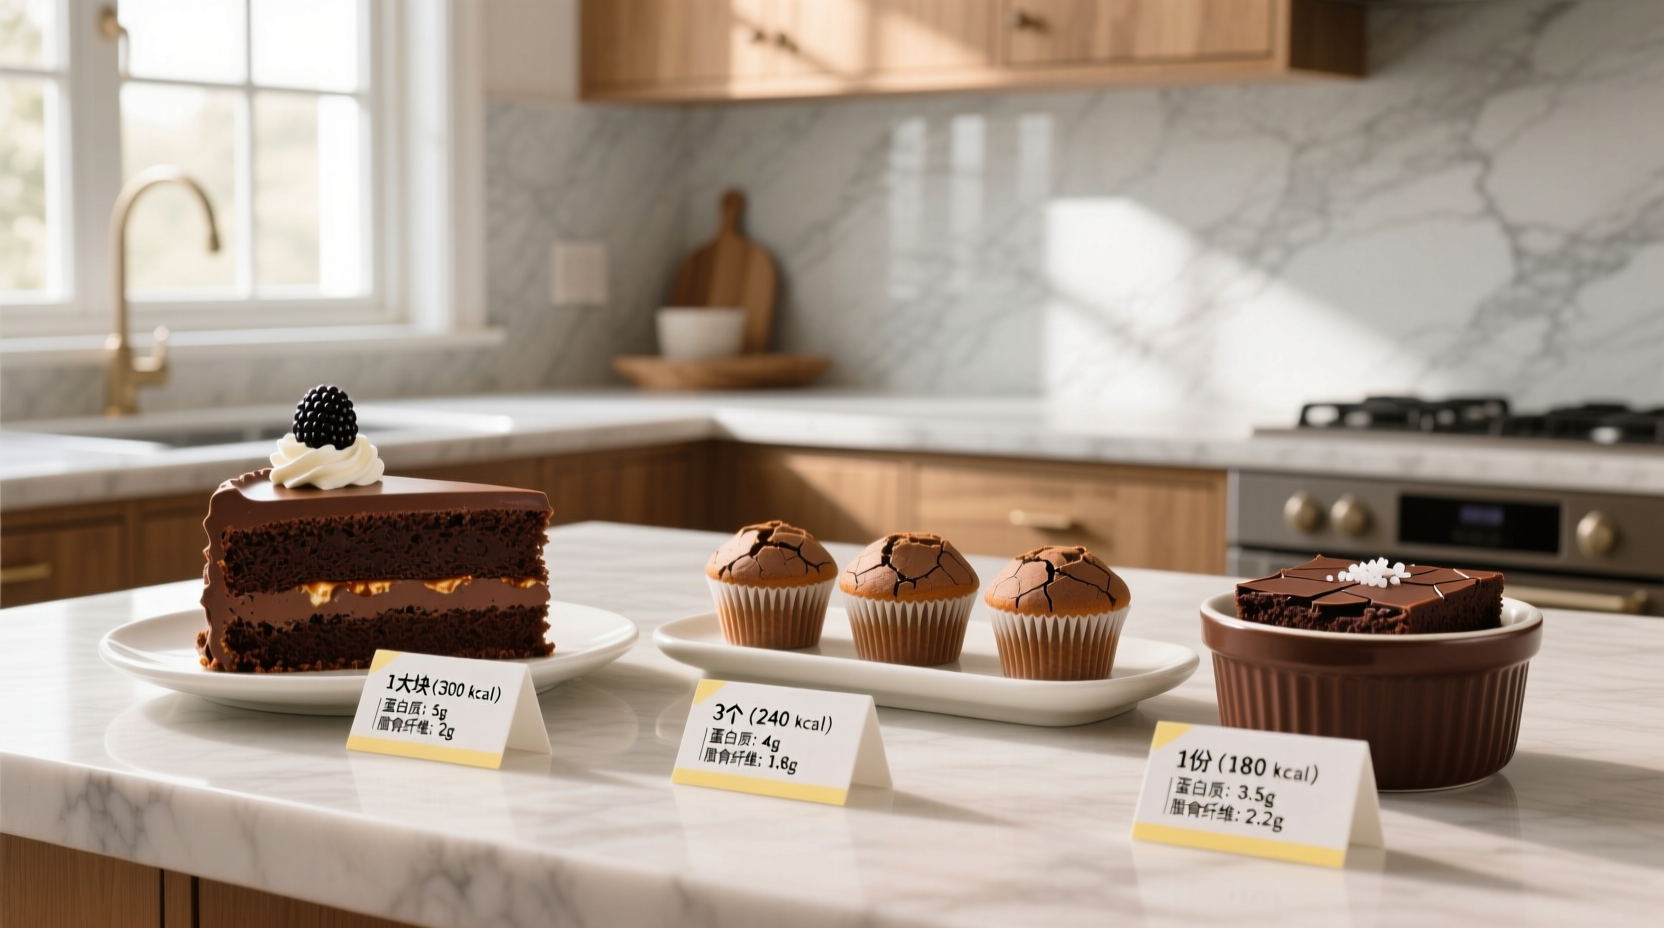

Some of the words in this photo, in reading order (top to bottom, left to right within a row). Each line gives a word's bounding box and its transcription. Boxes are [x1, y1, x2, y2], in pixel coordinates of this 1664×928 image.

[468, 685, 501, 704] kcal)
[432, 704, 448, 720] 5g
[713, 703, 743, 724] 3个
[750, 707, 790, 727] (240
[795, 715, 832, 735] kcal)
[438, 722, 455, 741] 2g
[761, 735, 781, 752] 4g
[1177, 749, 1212, 773] 1份
[1218, 753, 1267, 776] (180
[1273, 762, 1319, 785] kcal)
[1238, 785, 1275, 808] 3.5g
[1245, 809, 1284, 832] 2.2g
